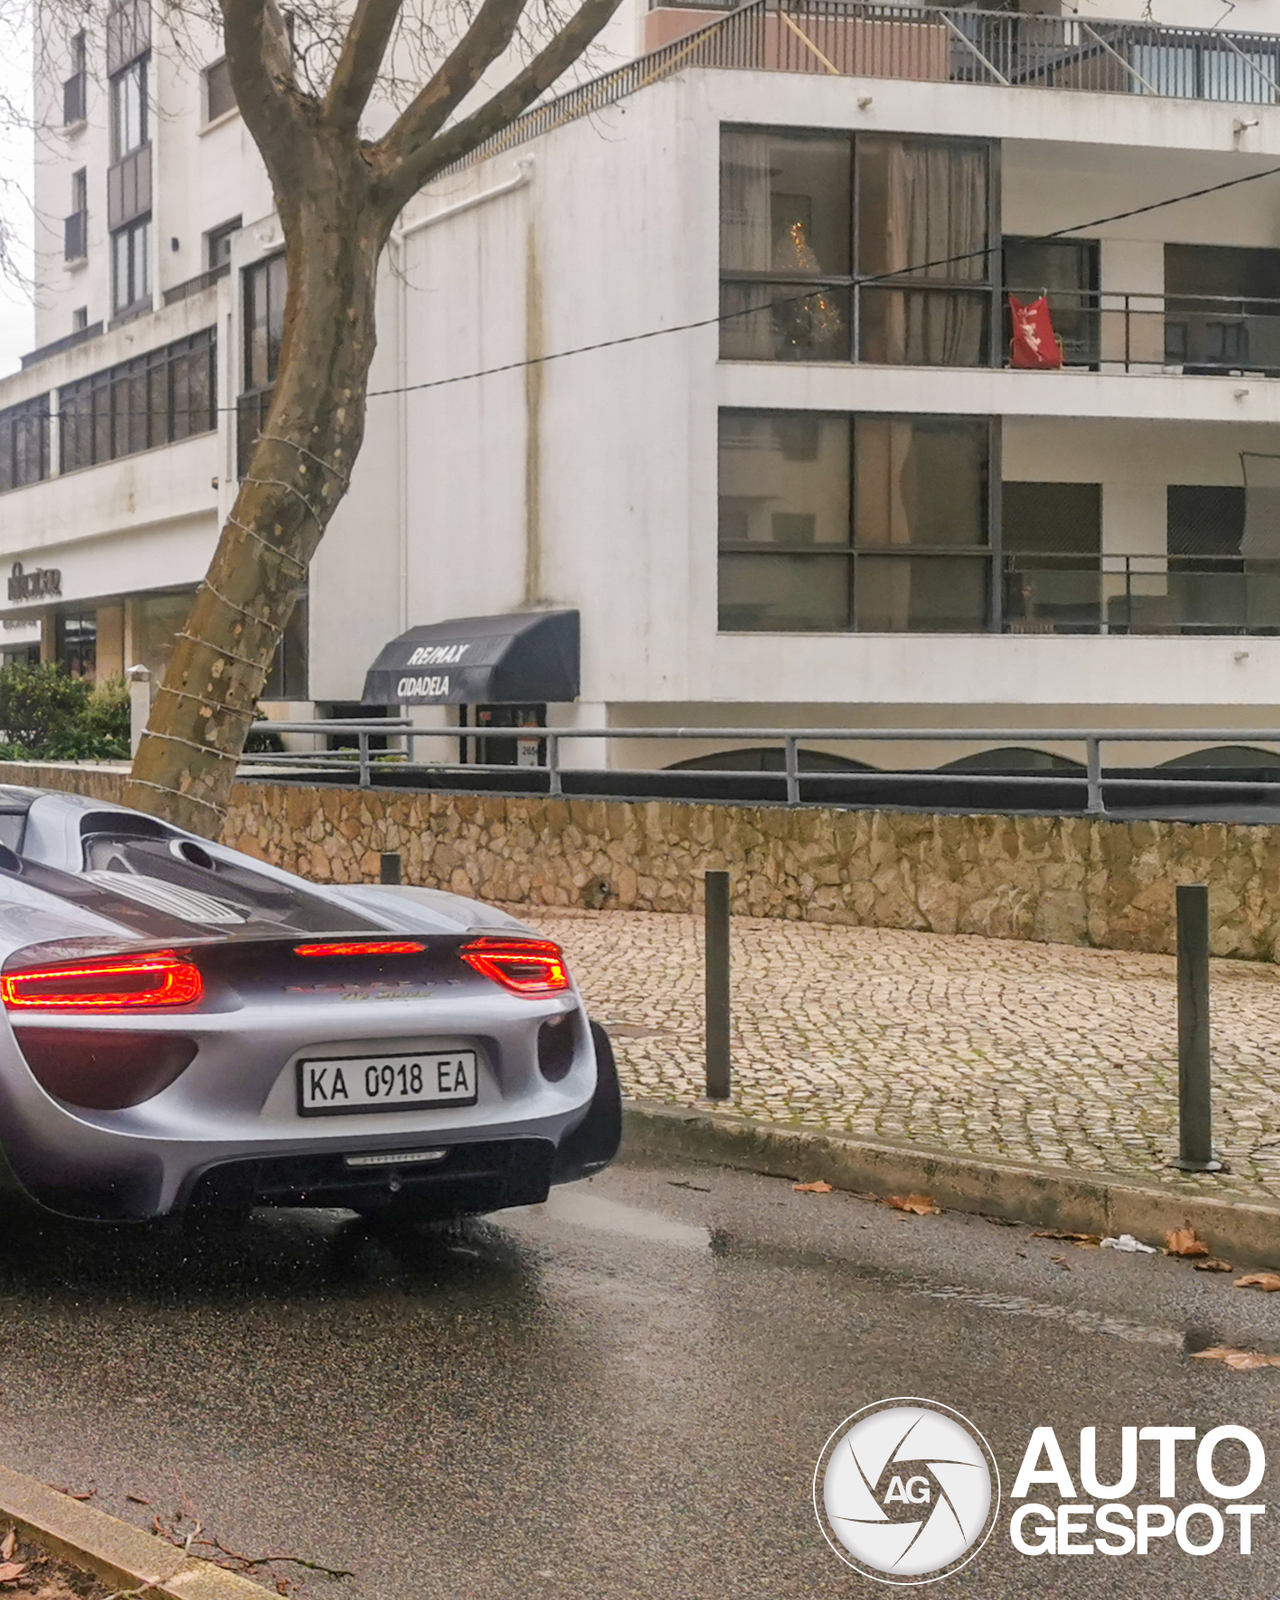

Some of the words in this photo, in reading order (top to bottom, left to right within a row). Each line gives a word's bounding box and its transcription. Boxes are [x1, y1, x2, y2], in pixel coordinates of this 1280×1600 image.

[407, 643, 470, 666] RE/MAX
[397, 675, 449, 698] CIDADELA
[310, 1067, 348, 1101] KA
[365, 1063, 423, 1097] 0918
[437, 1060, 469, 1092] EA
